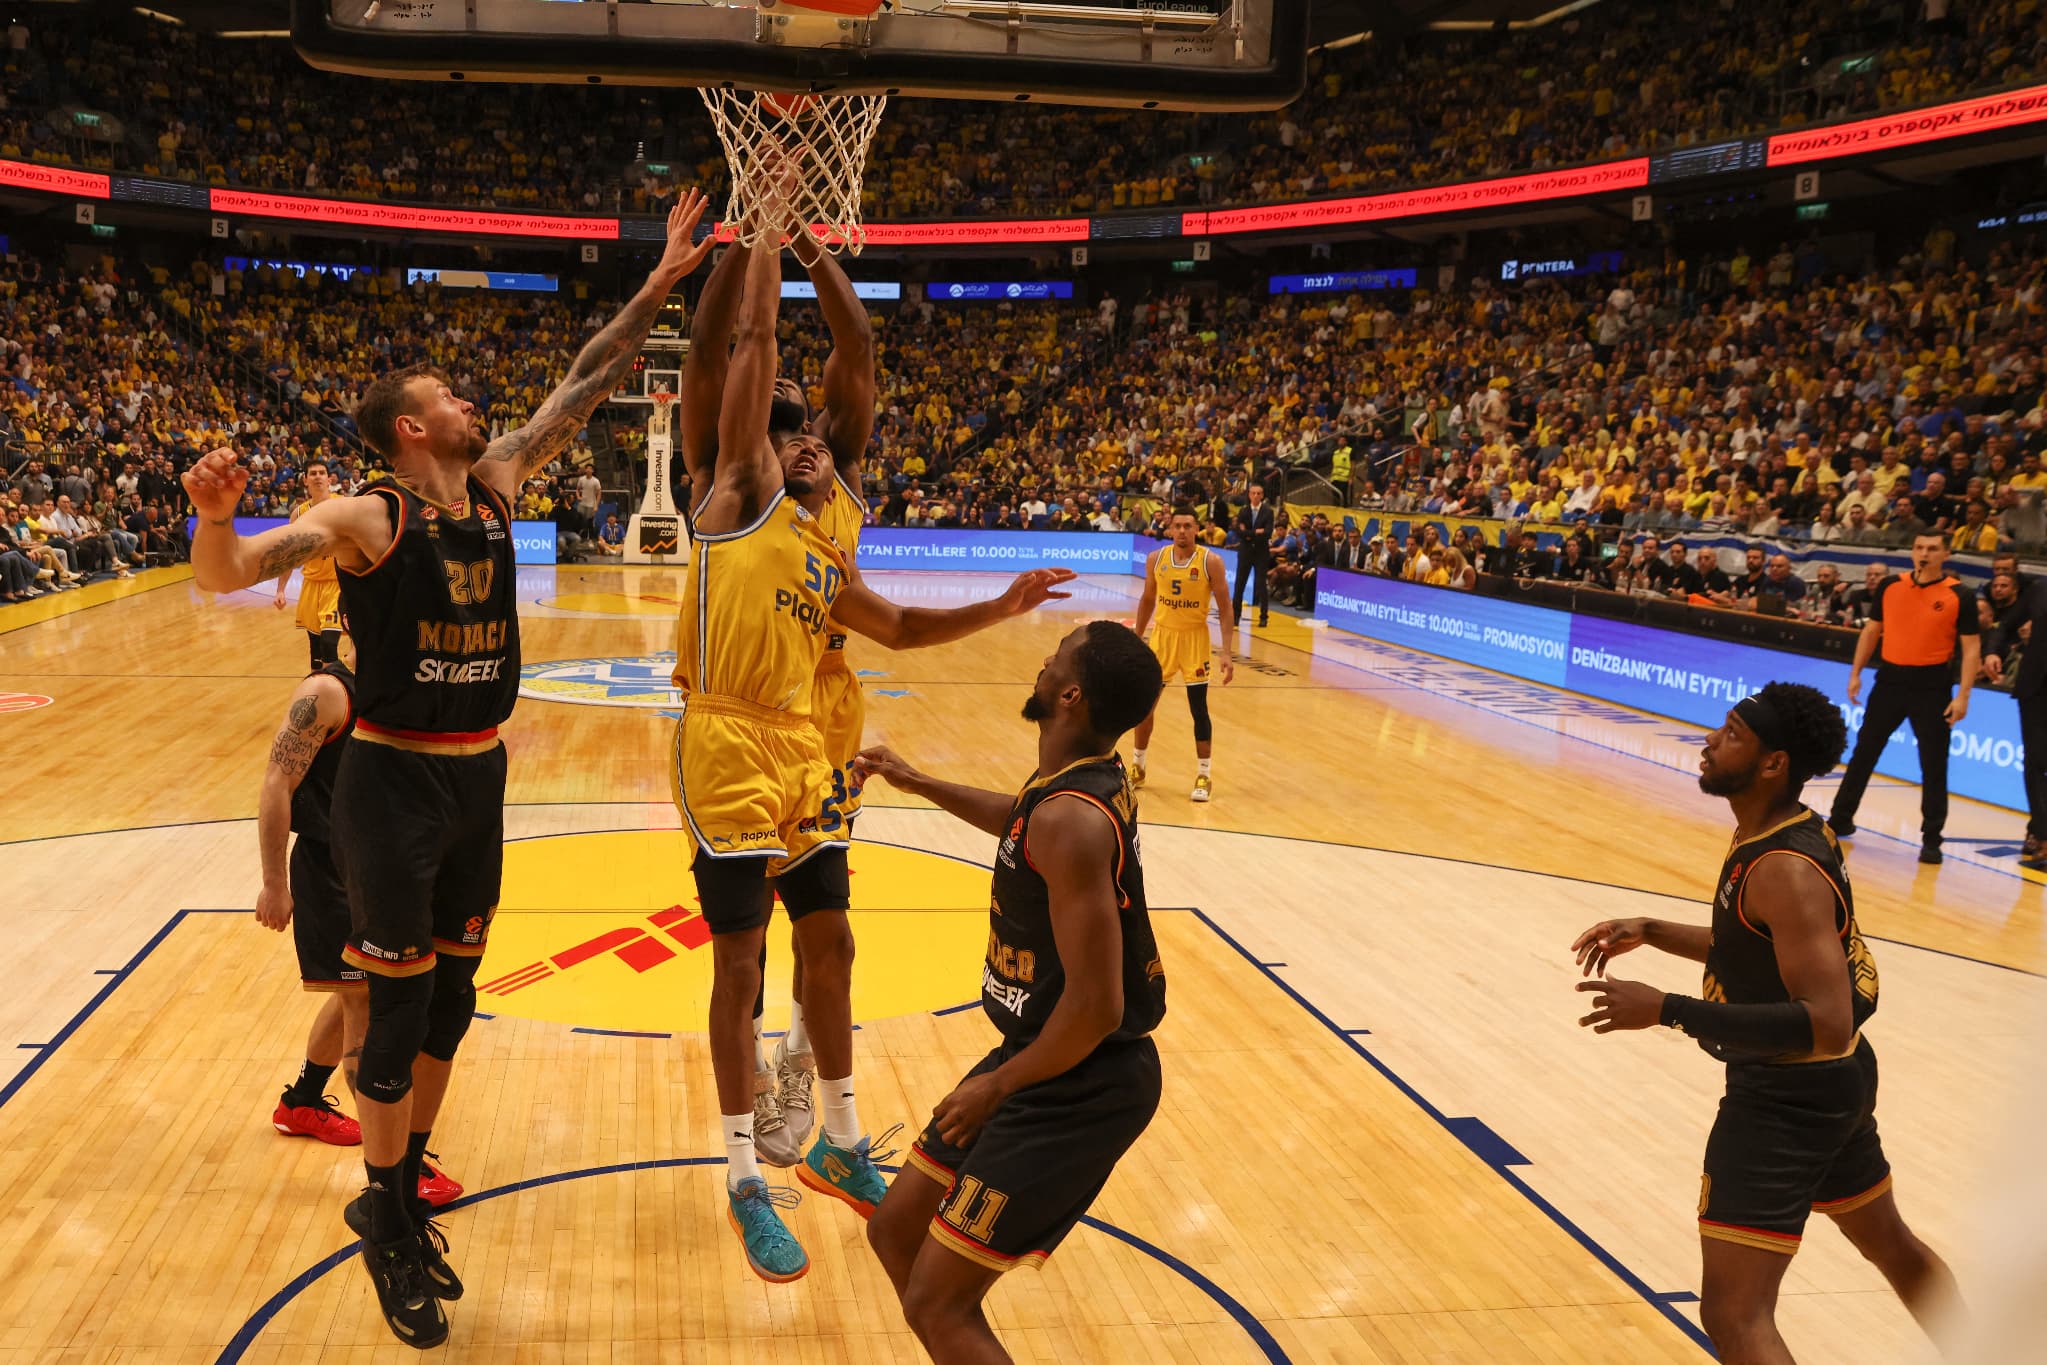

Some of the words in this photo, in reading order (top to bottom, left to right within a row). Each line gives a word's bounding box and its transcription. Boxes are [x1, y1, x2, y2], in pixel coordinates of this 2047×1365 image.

[1972, 95, 2047, 120] משלוחי
[215, 223, 225, 235] 5
[641, 520, 678, 530] Investing
[971, 546, 1016, 558] 10.000
[1042, 548, 1130, 560] PROMOSYON
[444, 559, 494, 604] 20
[805, 551, 840, 605] 50
[1171, 580, 1182, 595] 5
[1159, 596, 1199, 609] Playtika
[1429, 614, 1463, 637] 10.000
[1483, 626, 1565, 660] PROMOSYON
[740, 829, 776, 843] Rapyd
[943, 1174, 1008, 1244] 11
